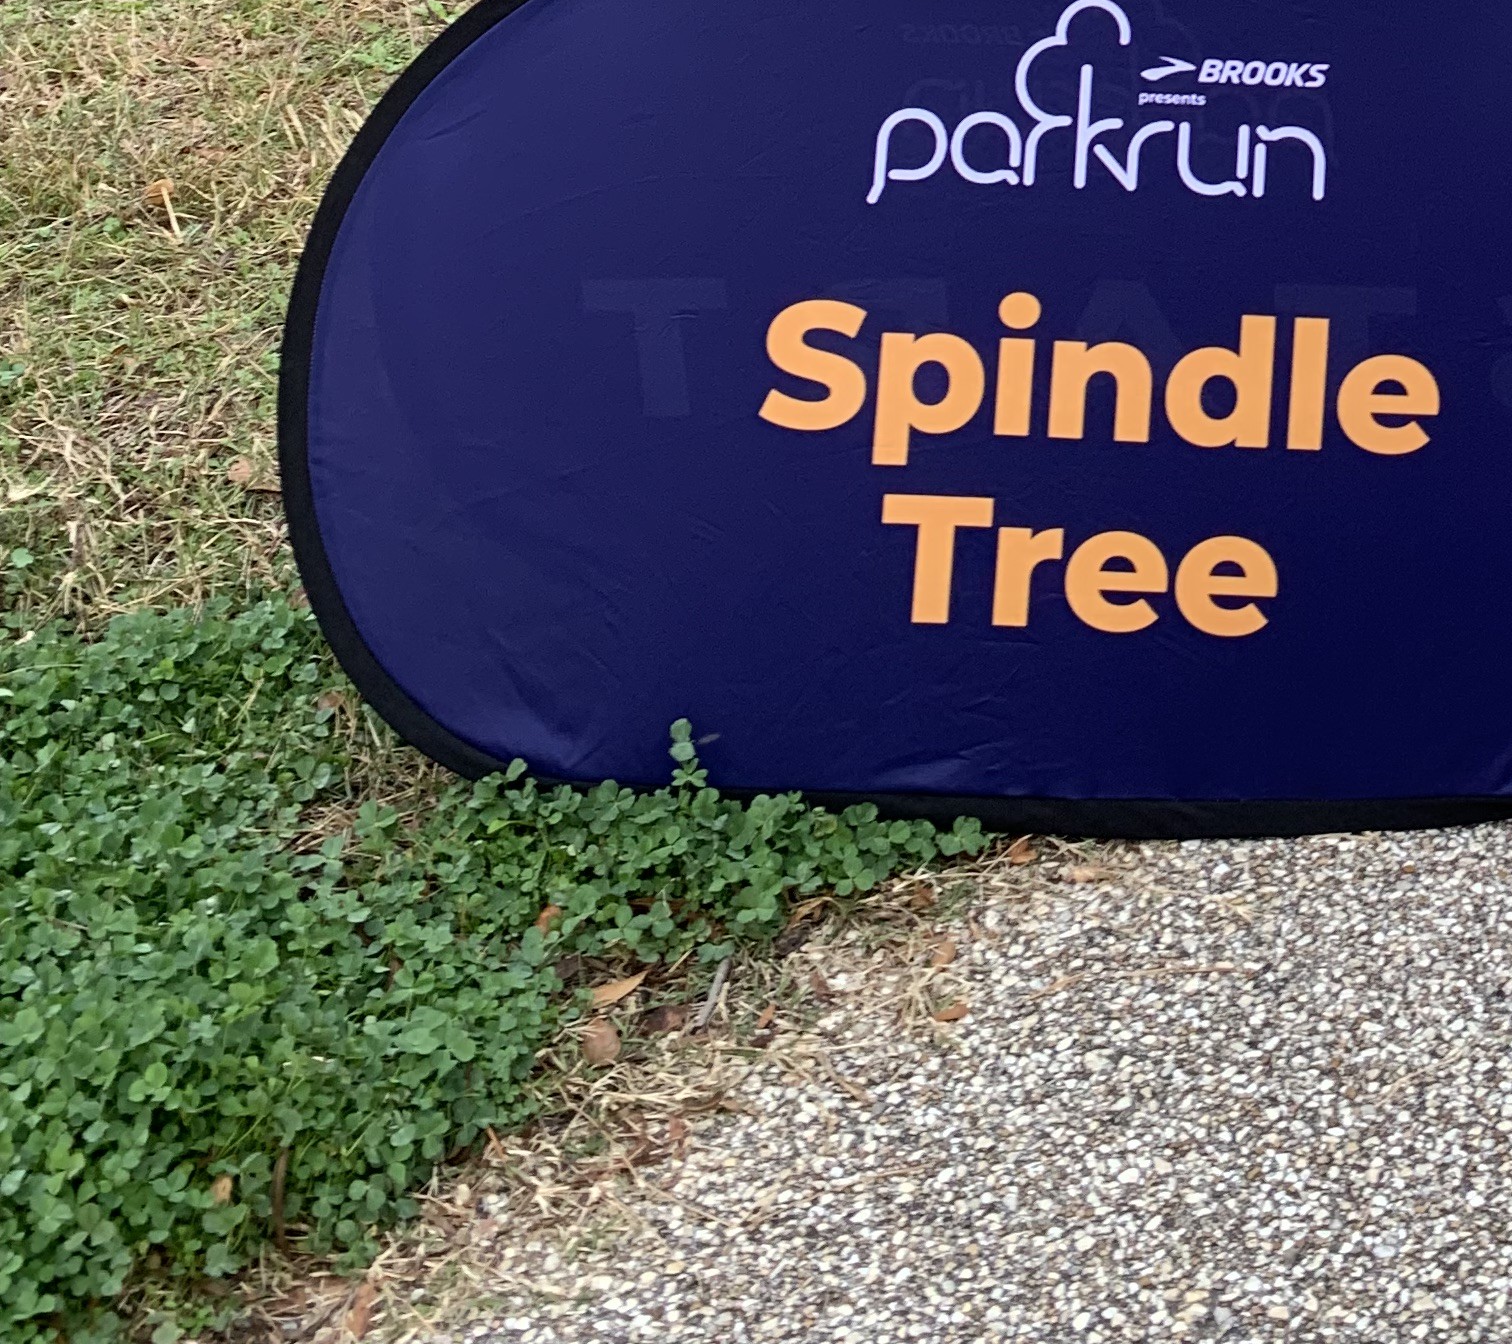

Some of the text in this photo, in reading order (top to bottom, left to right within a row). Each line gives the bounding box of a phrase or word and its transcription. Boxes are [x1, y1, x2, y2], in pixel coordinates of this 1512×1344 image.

[866, 64, 1329, 204] parkrun
[1137, 92, 1207, 106] presents
[1197, 58, 1330, 88] BROOKS
[758, 291, 1440, 466] Spindle
[881, 493, 1278, 637] Tree
